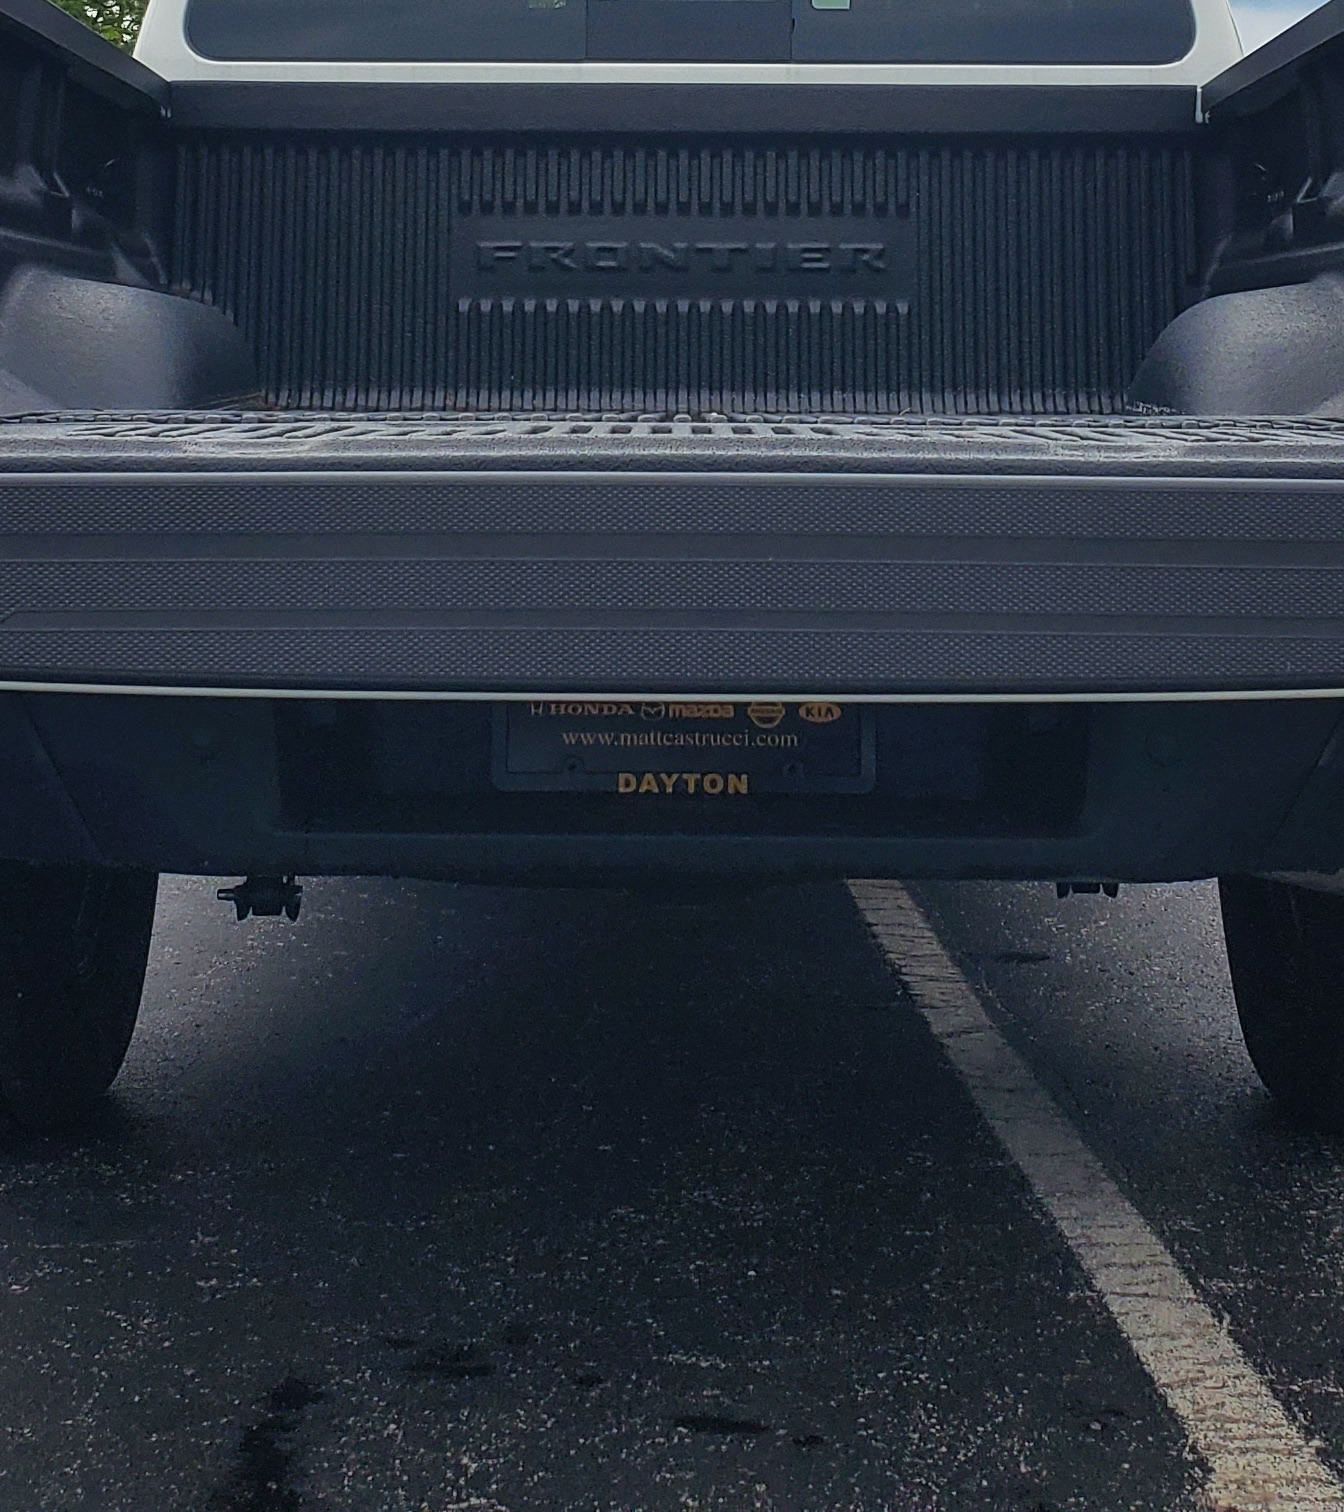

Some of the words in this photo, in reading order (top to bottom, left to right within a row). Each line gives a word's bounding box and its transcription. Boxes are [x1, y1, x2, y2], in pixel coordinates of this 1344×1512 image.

[476, 241, 886, 273] FRONTIER
[549, 703, 635, 715] HONDA
[805, 706, 835, 718] KIA
[561, 730, 798, 748] www.mattcastrucci.com
[617, 772, 749, 795] DAYTON
